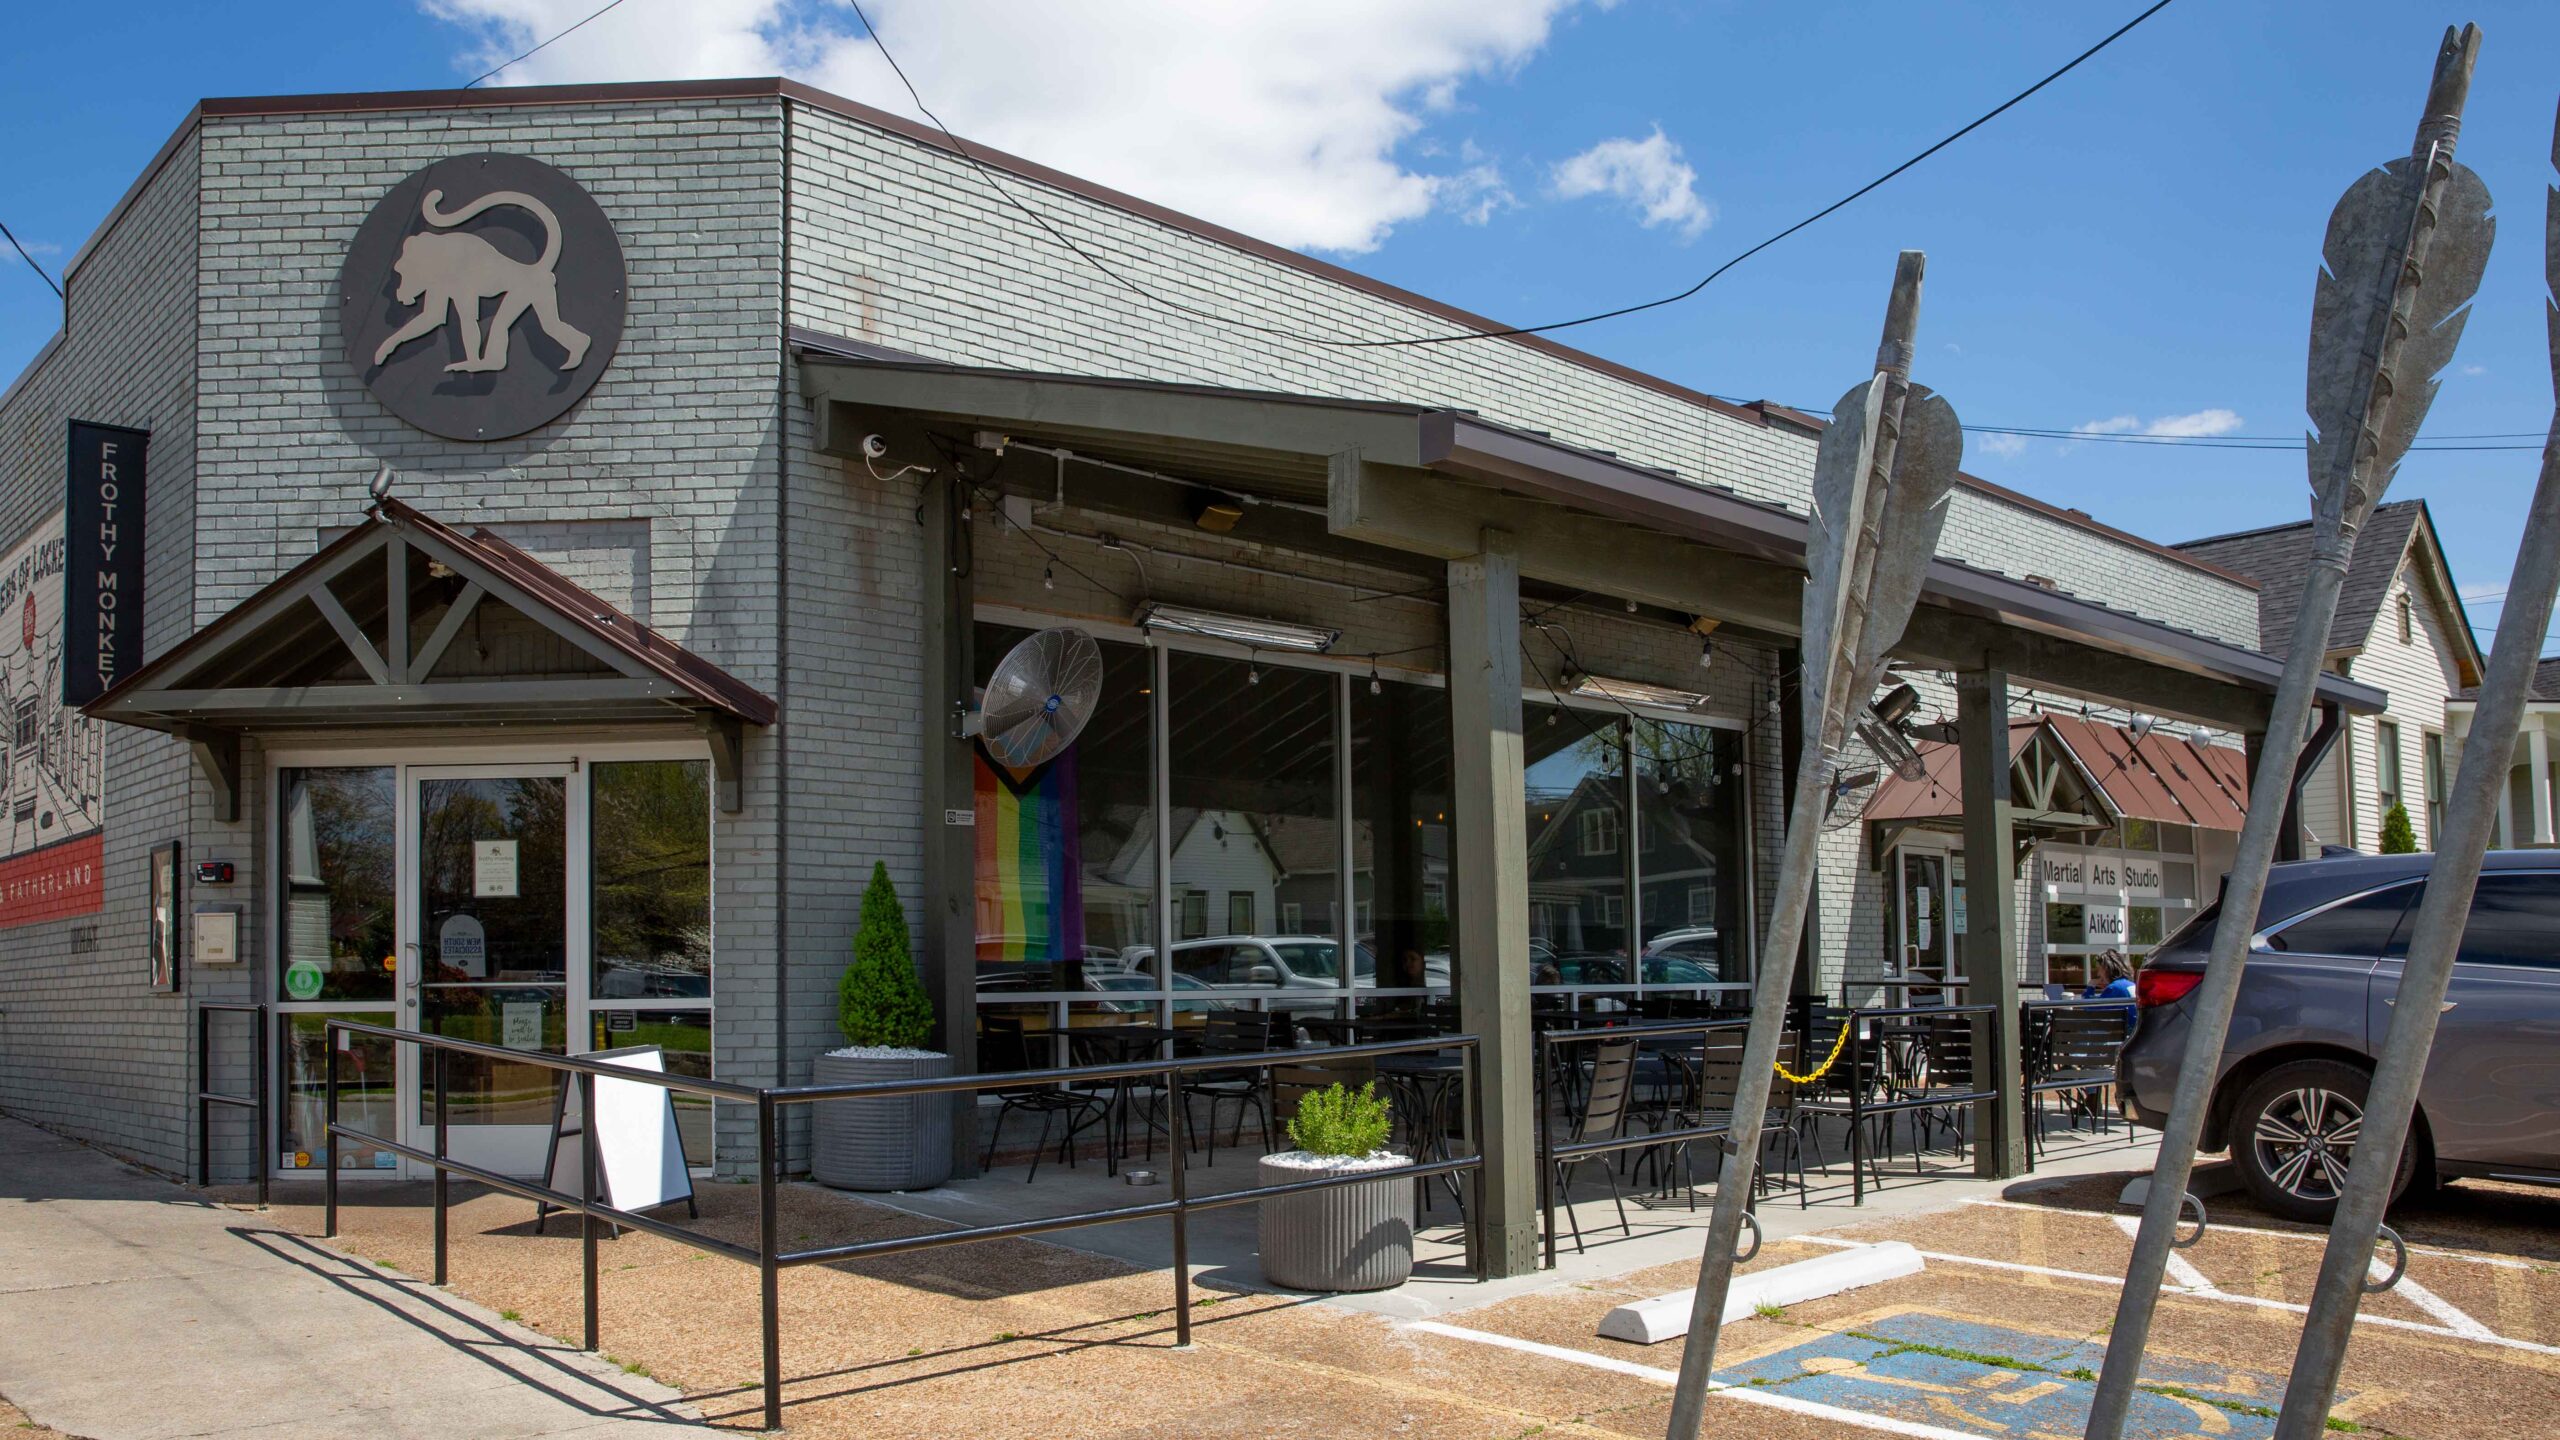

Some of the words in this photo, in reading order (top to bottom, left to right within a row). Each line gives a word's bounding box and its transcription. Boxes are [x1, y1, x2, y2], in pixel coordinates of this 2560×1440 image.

[100, 442, 118, 561] FROTHY
[19, 555, 30, 594] OF
[98, 571, 117, 691] MONKEY
[10, 863, 91, 901] FATHERLAND
[2043, 861, 2082, 883] Martial
[2093, 864, 2116, 885] Arts
[2125, 866, 2158, 888] Studio
[2089, 913, 2124, 934] Aikido
